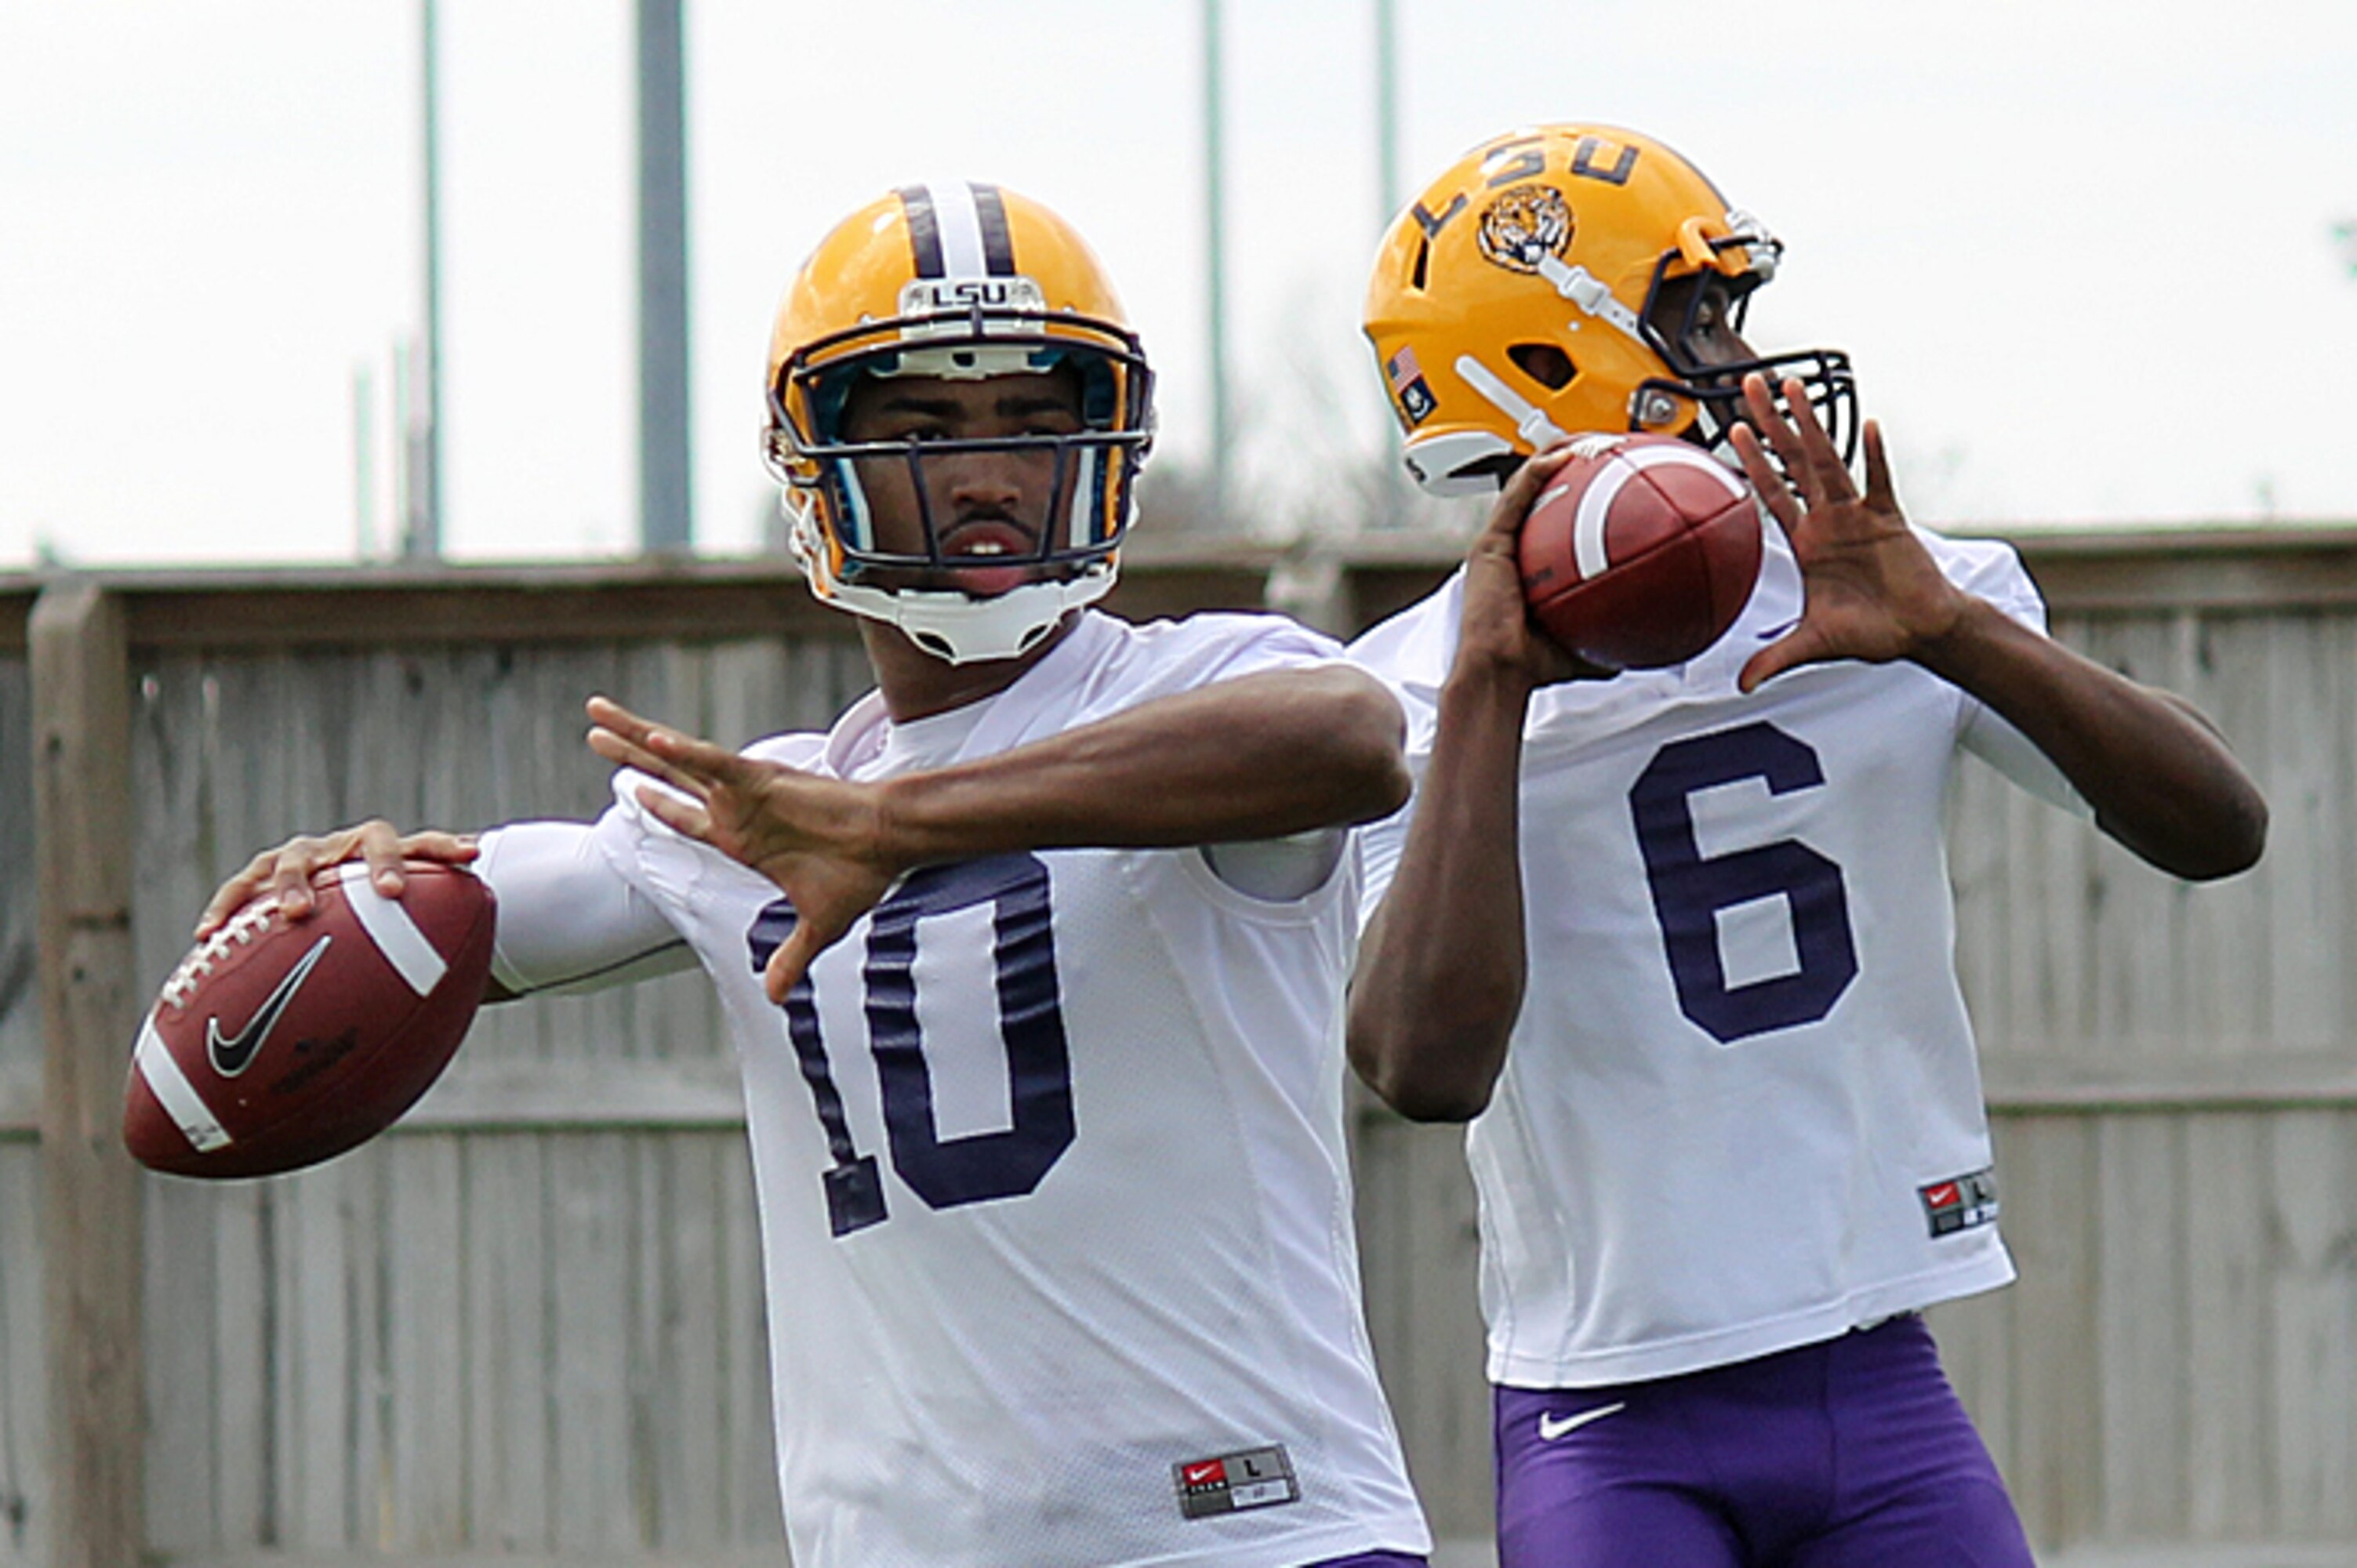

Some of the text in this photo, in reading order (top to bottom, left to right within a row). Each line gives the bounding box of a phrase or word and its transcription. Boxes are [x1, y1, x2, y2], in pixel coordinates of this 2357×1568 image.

[1413, 136, 1639, 238] LSU
[932, 283, 1006, 306] LSU
[1629, 720, 1859, 1044] 6
[748, 851, 1077, 1237] 10
[1244, 1459, 1261, 1477] L
